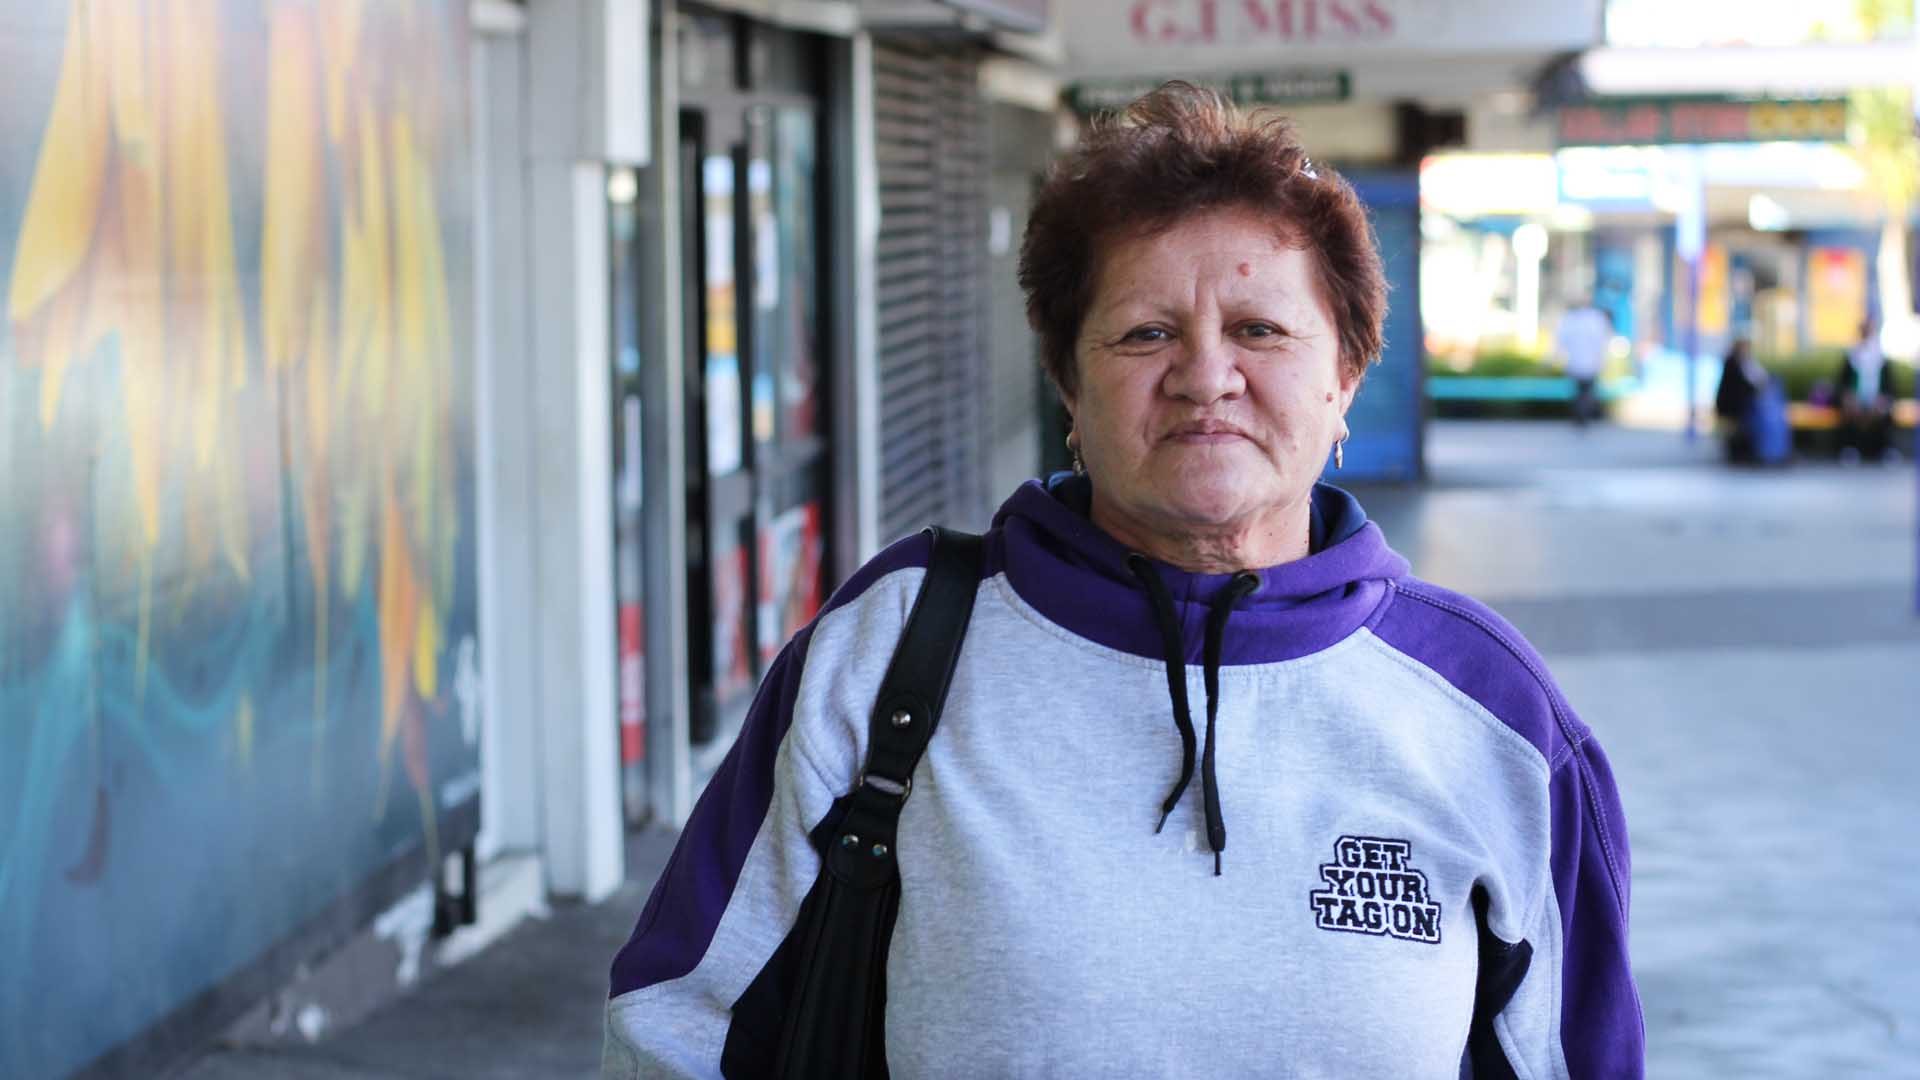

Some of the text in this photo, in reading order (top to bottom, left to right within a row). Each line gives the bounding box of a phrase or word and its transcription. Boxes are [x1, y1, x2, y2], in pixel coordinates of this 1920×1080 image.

[1340, 840, 1405, 871] GET
[1324, 868, 1424, 903] YOUR
[1315, 896, 1438, 937] TAG ON
